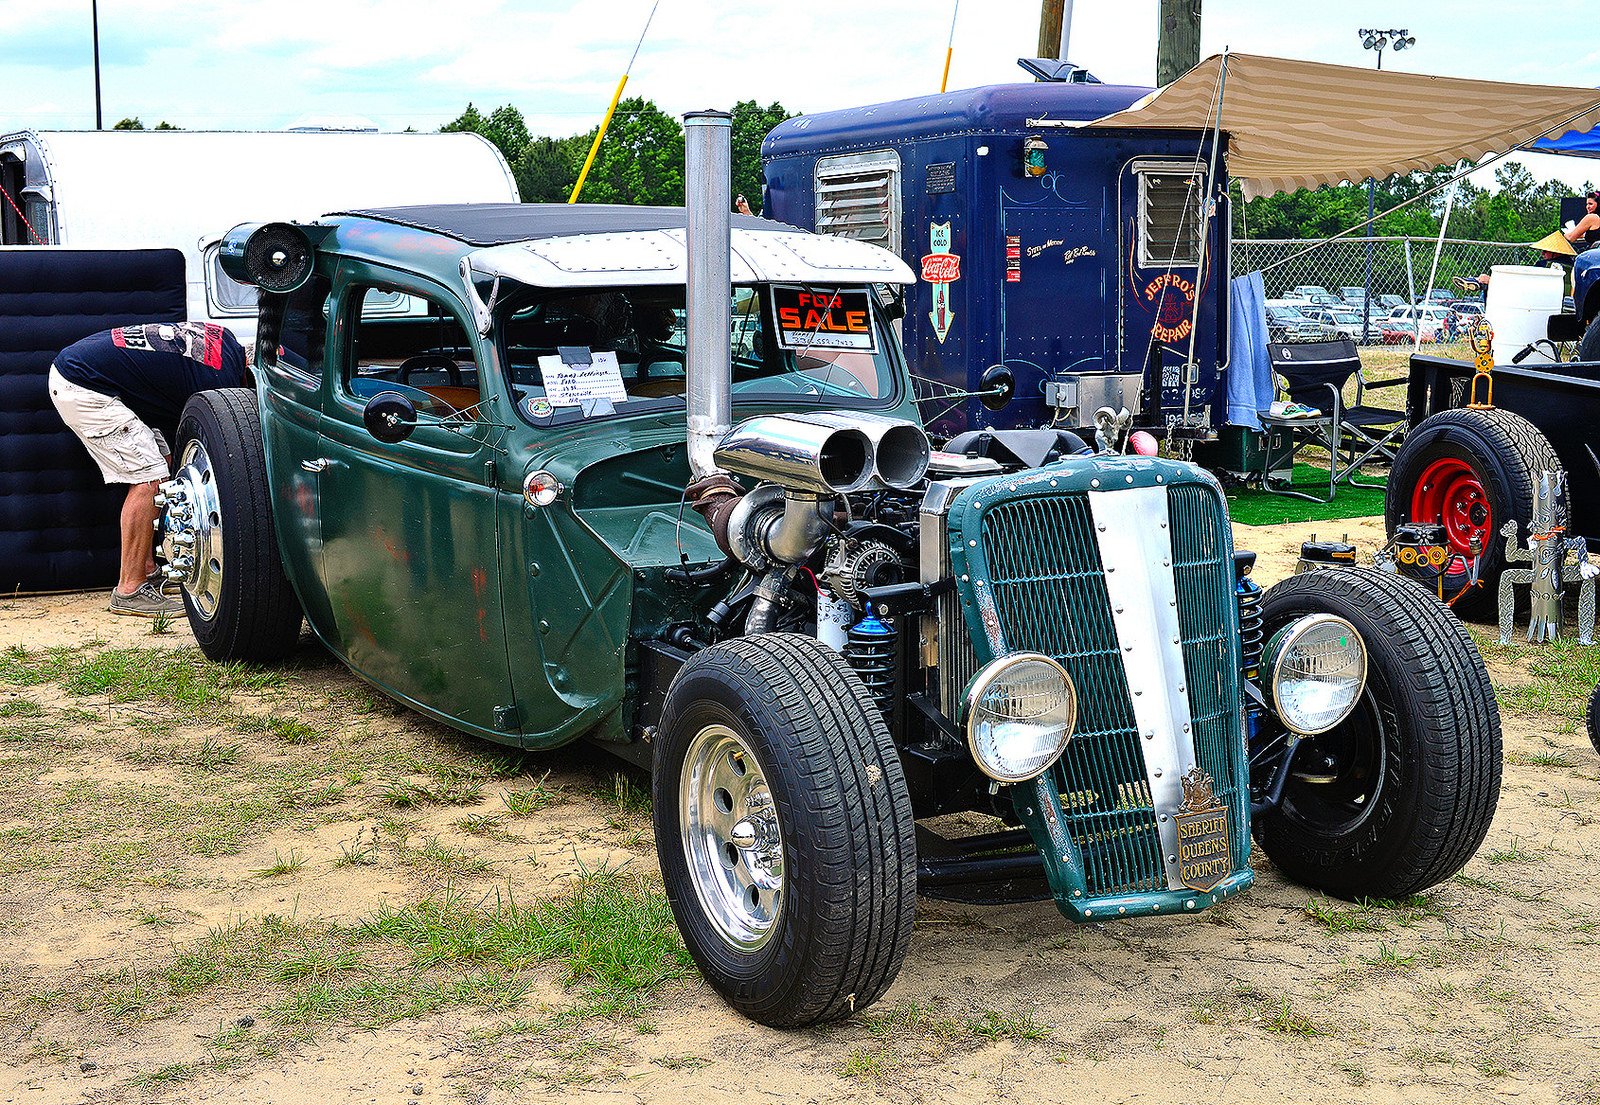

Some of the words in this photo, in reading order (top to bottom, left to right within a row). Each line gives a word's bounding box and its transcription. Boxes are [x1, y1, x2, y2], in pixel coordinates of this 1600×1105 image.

[933, 239, 947, 247] COLD
[922, 258, 959, 279] Coca-Cola
[1145, 274, 1195, 301] JEFFRO'S
[799, 293, 842, 308] FOR
[780, 307, 868, 331] SALE
[1151, 319, 1192, 343] REPAIR
[1180, 817, 1225, 838] SHERIFF
[1181, 837, 1227, 861] QUEENS
[1183, 858, 1227, 880] COUNTY
